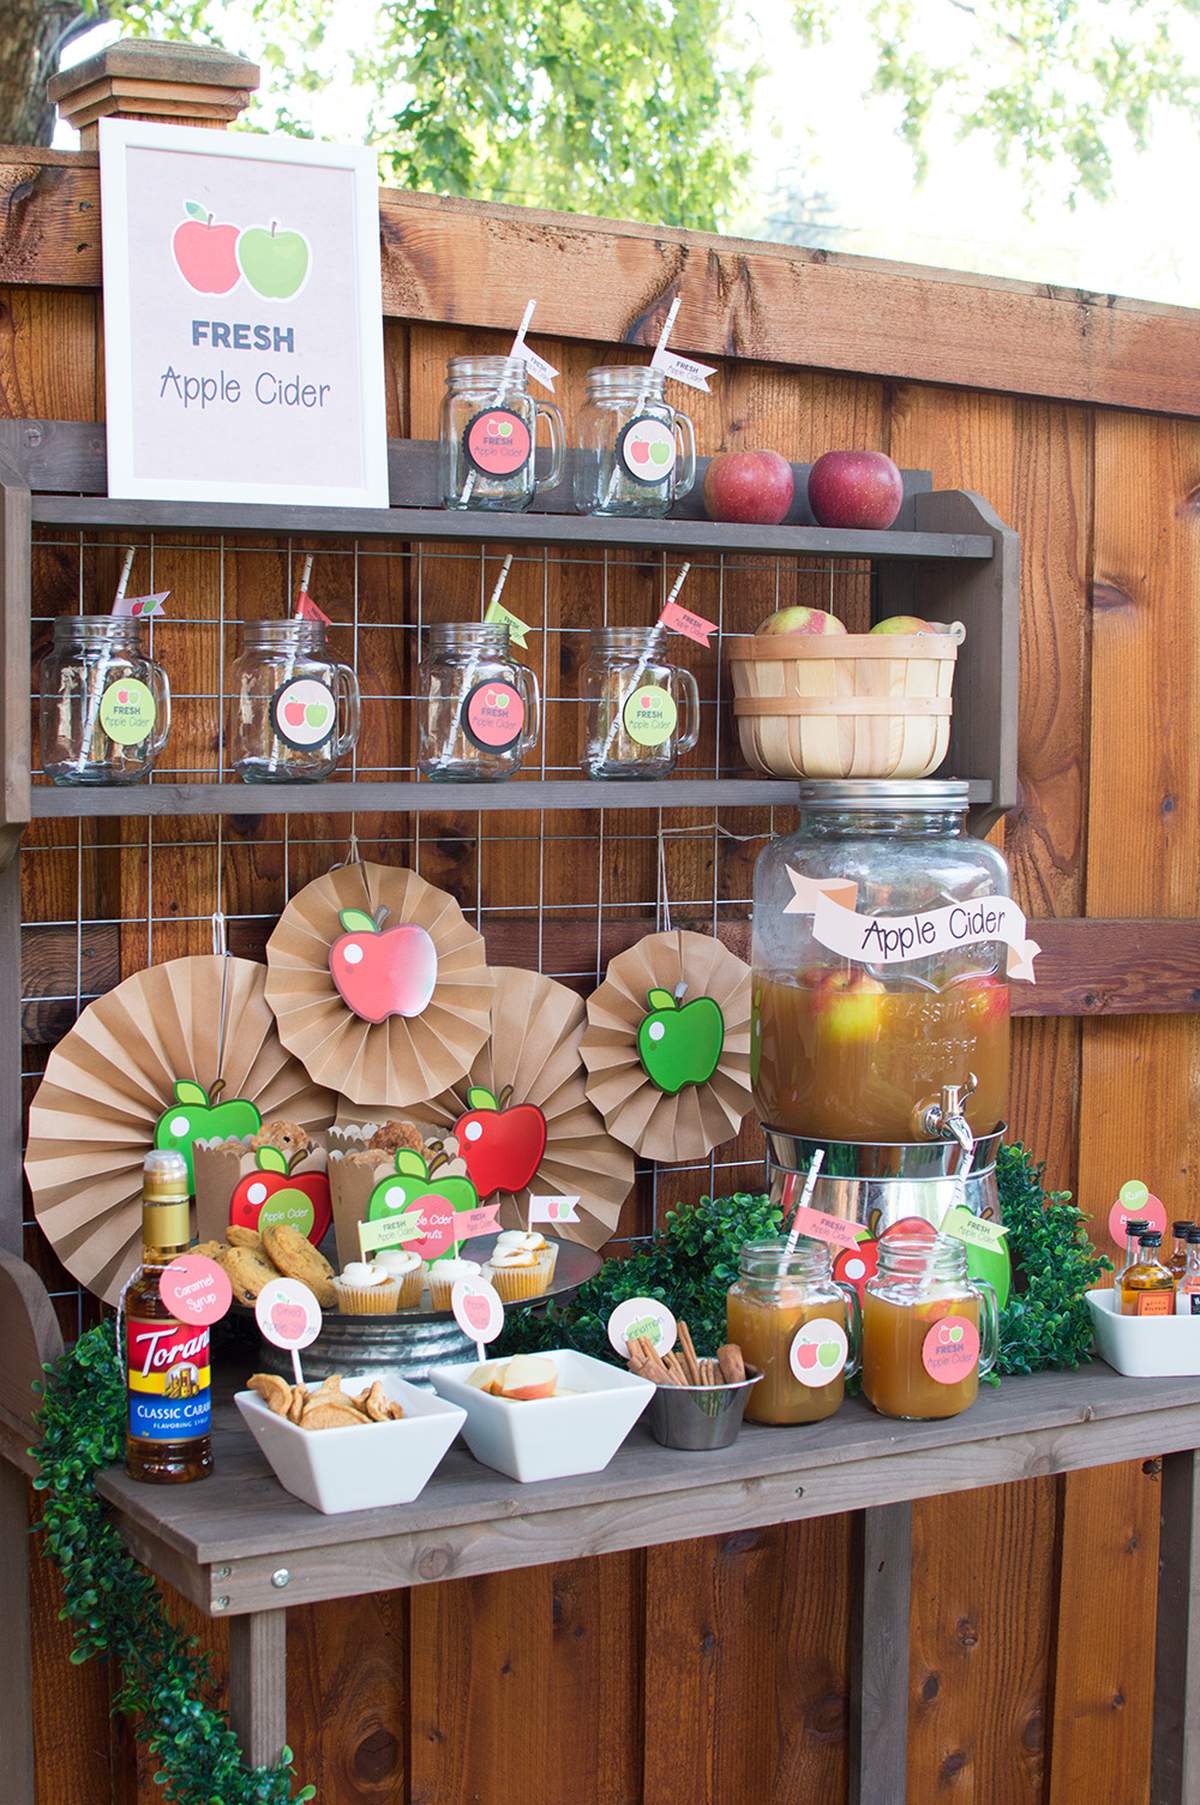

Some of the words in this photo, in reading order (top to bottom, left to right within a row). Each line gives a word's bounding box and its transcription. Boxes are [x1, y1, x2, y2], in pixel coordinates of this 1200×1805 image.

[192, 319, 295, 353] FRESH
[676, 361, 699, 374] FRESH
[160, 366, 241, 409] Apple
[255, 371, 331, 408] Cider
[483, 437, 513, 446] FRESH
[474, 446, 498, 458] Apple
[500, 446, 523, 458] Cider
[682, 614, 704, 628] FRESH
[113, 706, 141, 715] FRESH
[480, 707, 509, 718] FRESH
[636, 710, 664, 720] FRESH
[105, 716, 127, 727] Apple
[129, 717, 150, 728] Cider
[473, 716, 495, 729] Apple
[495, 719, 517, 730] Cider
[628, 720, 650, 730] Apple
[651, 721, 672, 730] Cider
[861, 916, 936, 959] Apple
[949, 904, 1006, 939] Cider
[264, 1210, 286, 1223] Apple
[287, 1207, 309, 1219] Cider
[430, 1214, 454, 1225] Cider
[383, 1220, 408, 1232] FRESH
[820, 1218, 846, 1231] FRESH
[967, 1220, 991, 1234] FRESH
[173, 1274, 215, 1299] Caramel
[185, 1292, 217, 1313] Syrup
[936, 1343, 965, 1355] FRESH
[927, 1356, 951, 1370] Apple
[951, 1353, 973, 1364] Cider
[137, 1405, 181, 1420] CLASSIC
[153, 1421, 193, 1430] FLAVORING
